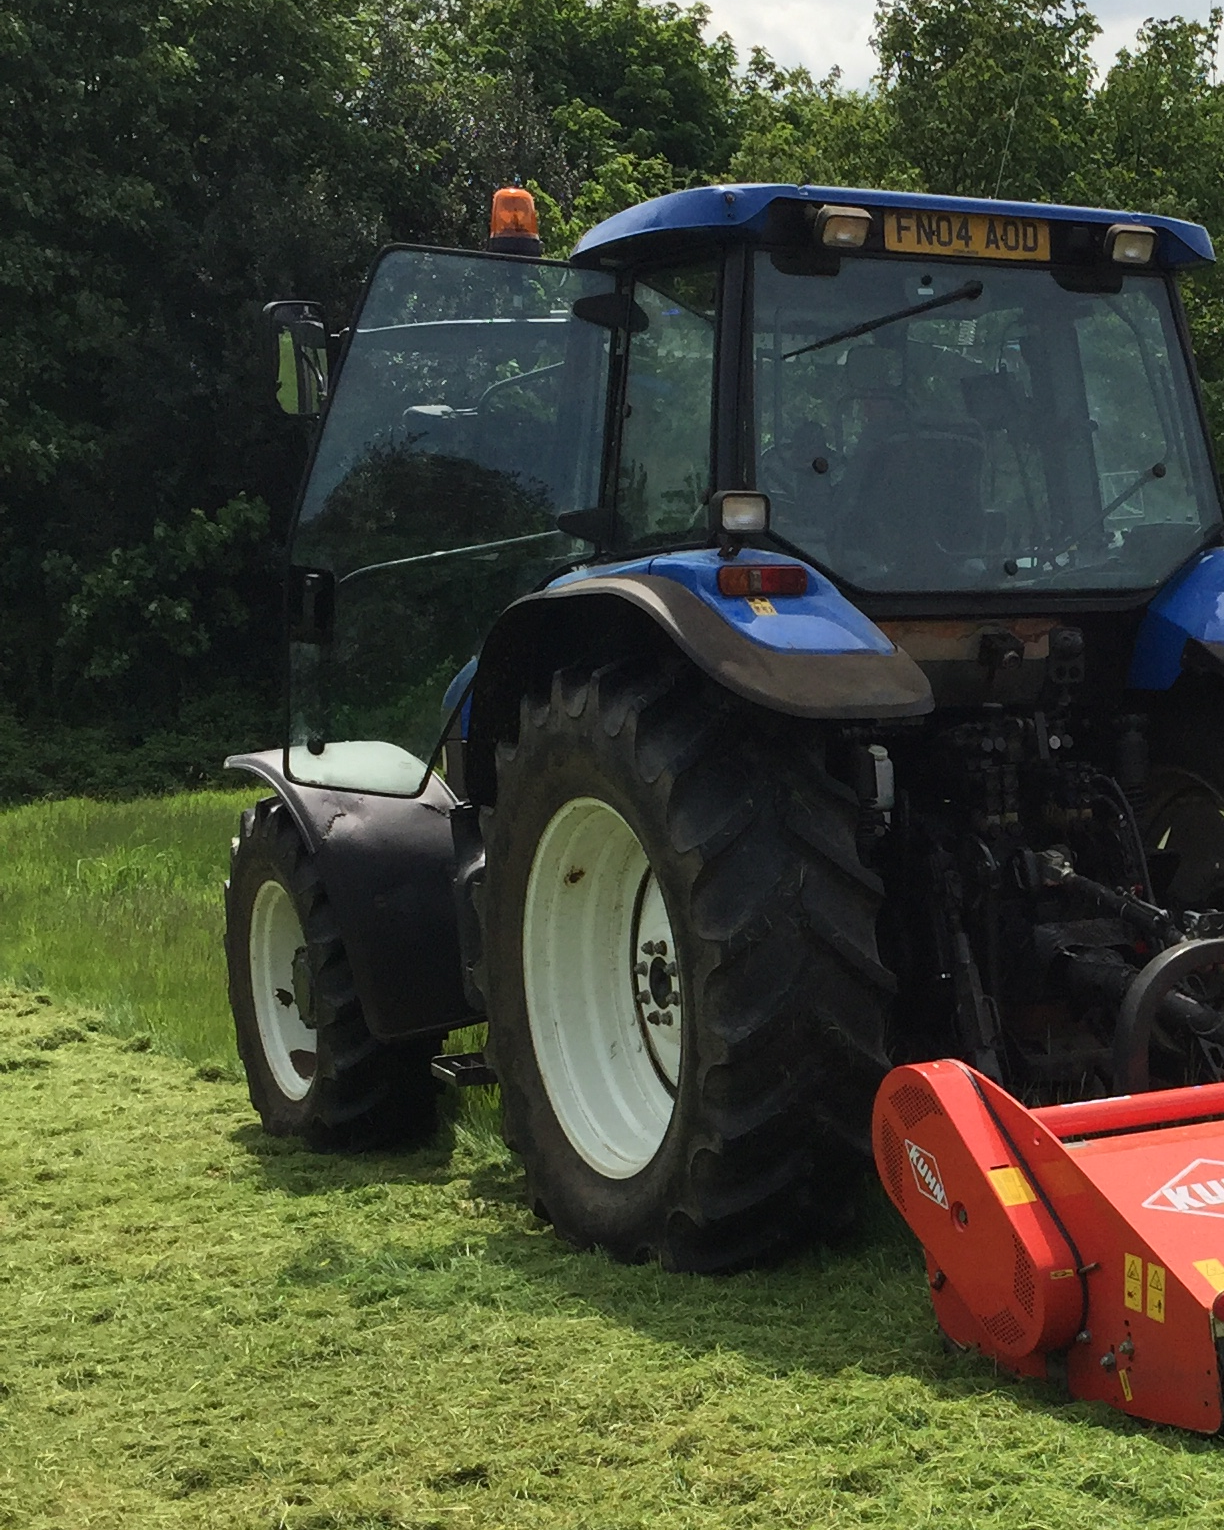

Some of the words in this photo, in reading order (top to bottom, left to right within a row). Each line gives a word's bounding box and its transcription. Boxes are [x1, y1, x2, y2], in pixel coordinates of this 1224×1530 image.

[895, 213, 972, 248] FN04
[985, 217, 1038, 252] AOD
[908, 1144, 946, 1204] KUHN
